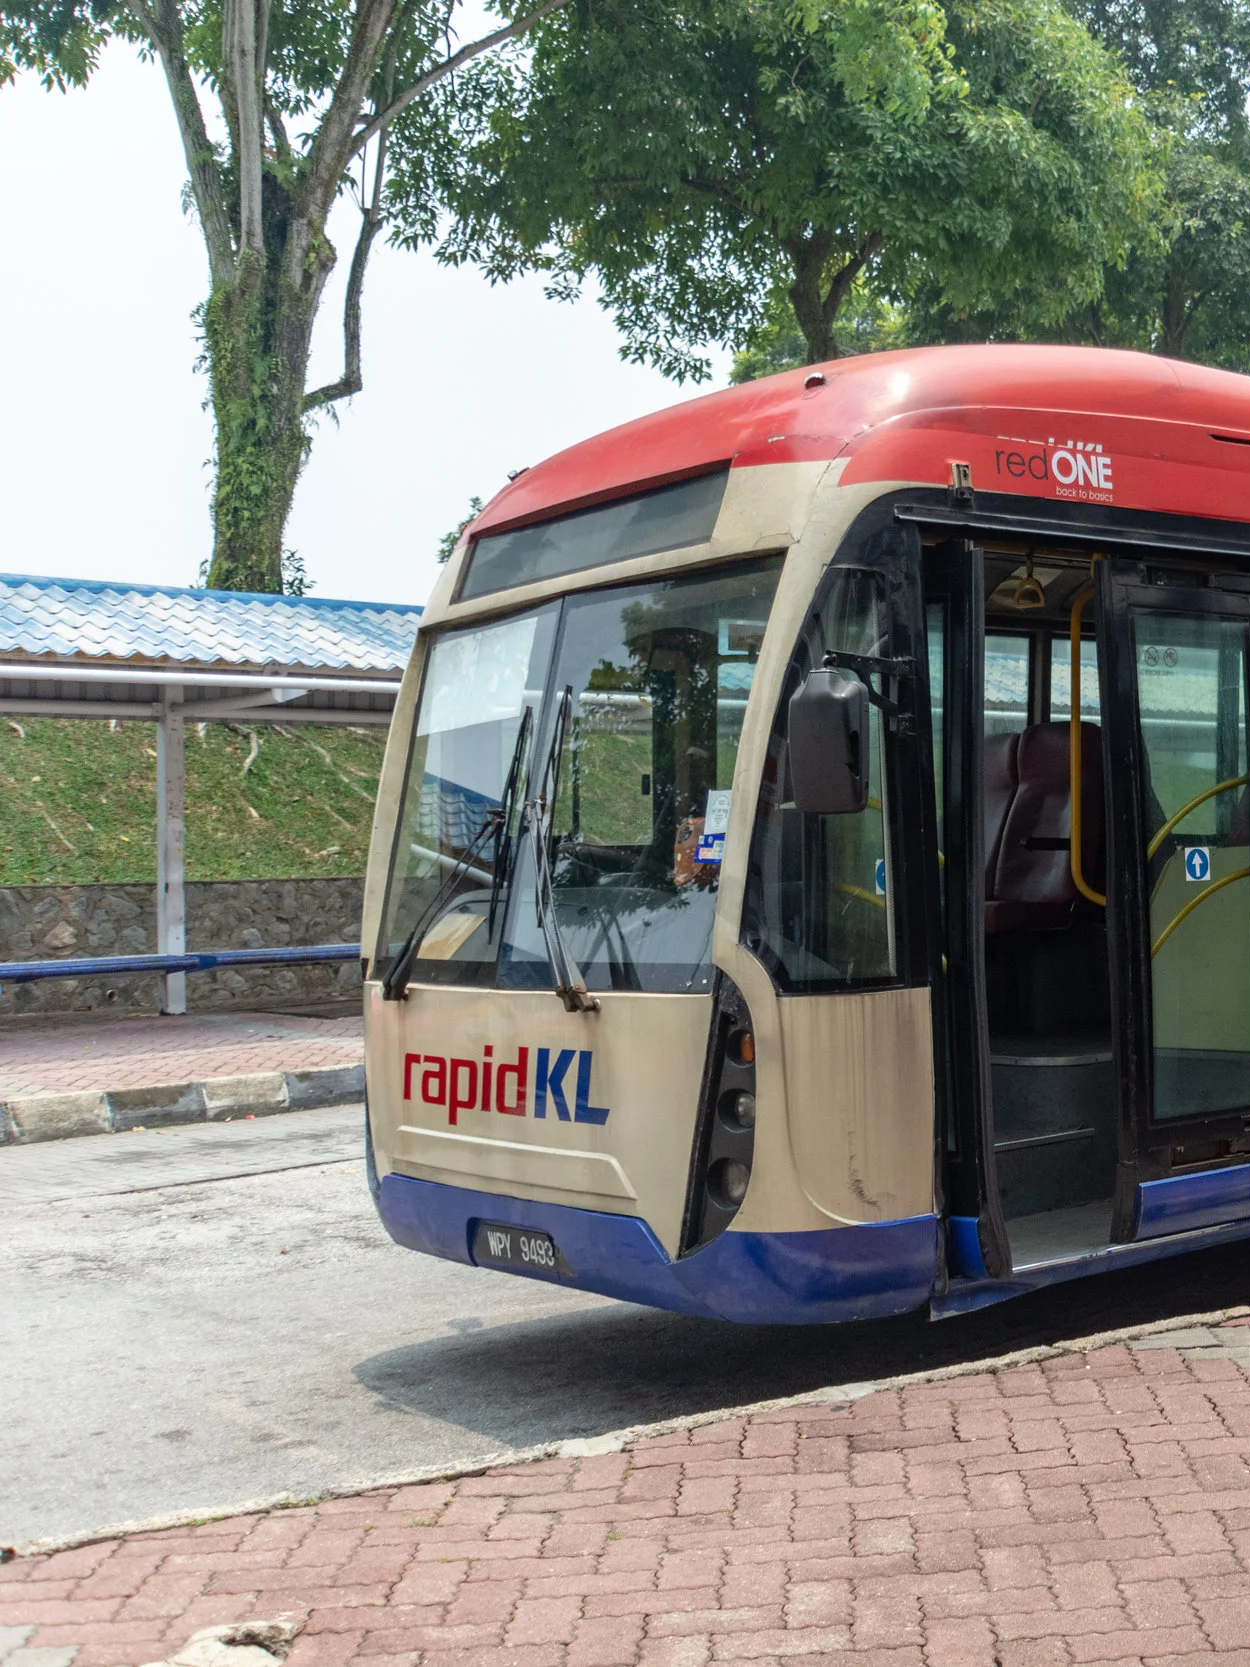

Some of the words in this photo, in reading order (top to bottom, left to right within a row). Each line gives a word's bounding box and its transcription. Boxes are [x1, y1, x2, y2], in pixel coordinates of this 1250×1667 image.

[995, 448, 1114, 490] redONE
[1056, 486, 1077, 498] back
[1079, 489, 1088, 500] to
[1089, 491, 1113, 503] basics
[403, 1044, 611, 1126] rapidKL
[487, 1230, 512, 1259] WPY
[520, 1236, 555, 1266] 9493
